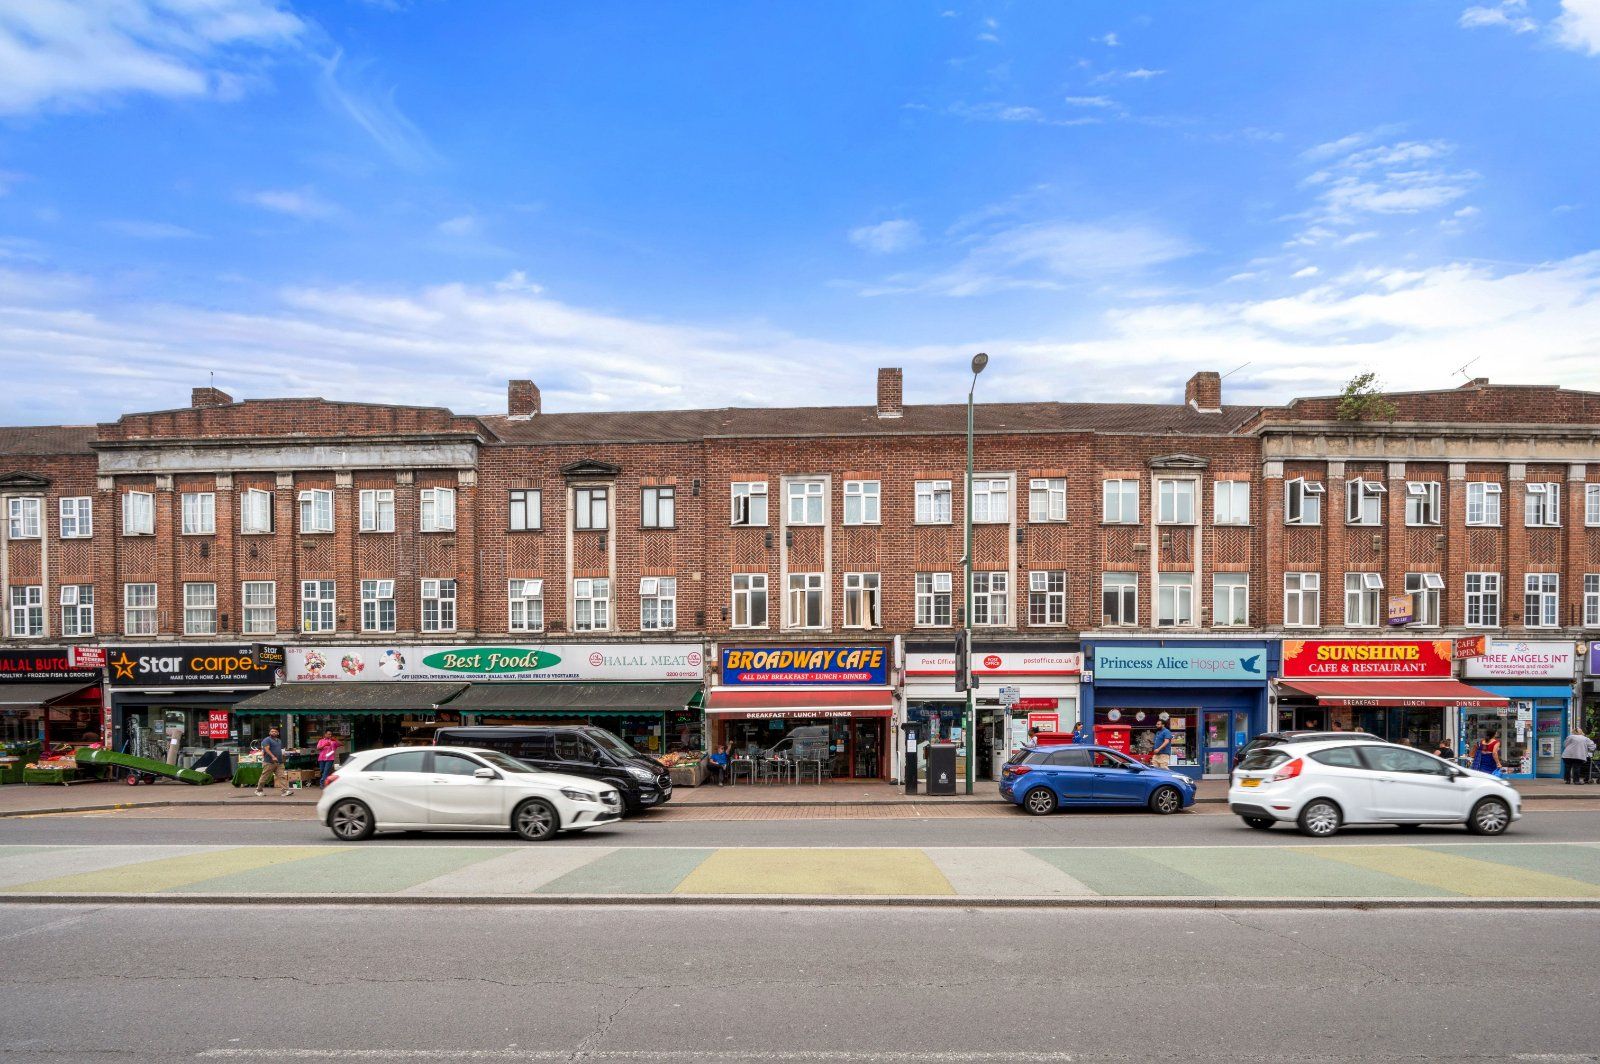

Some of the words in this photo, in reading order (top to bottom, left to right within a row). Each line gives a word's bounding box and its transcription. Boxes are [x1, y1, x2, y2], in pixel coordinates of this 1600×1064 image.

[1457, 640, 1475, 648] CAFE
[727, 650, 835, 670] BROADWAY
[836, 650, 882, 670] CAFE
[1317, 646, 1420, 660] SUNSHINE
[1457, 648, 1476, 658] OPEN
[139, 656, 183, 673] Star
[443, 654, 481, 668] Best
[485, 651, 538, 671] Foods
[604, 656, 647, 666] HALAL
[650, 656, 688, 666] MEAT
[1100, 656, 1152, 668] Princess
[1156, 656, 1188, 668] Alice
[1190, 658, 1236, 672] Hospice
[1308, 664, 1338, 672] CAFE
[1340, 664, 1349, 672] &
[1352, 663, 1426, 672] RESTAURANT
